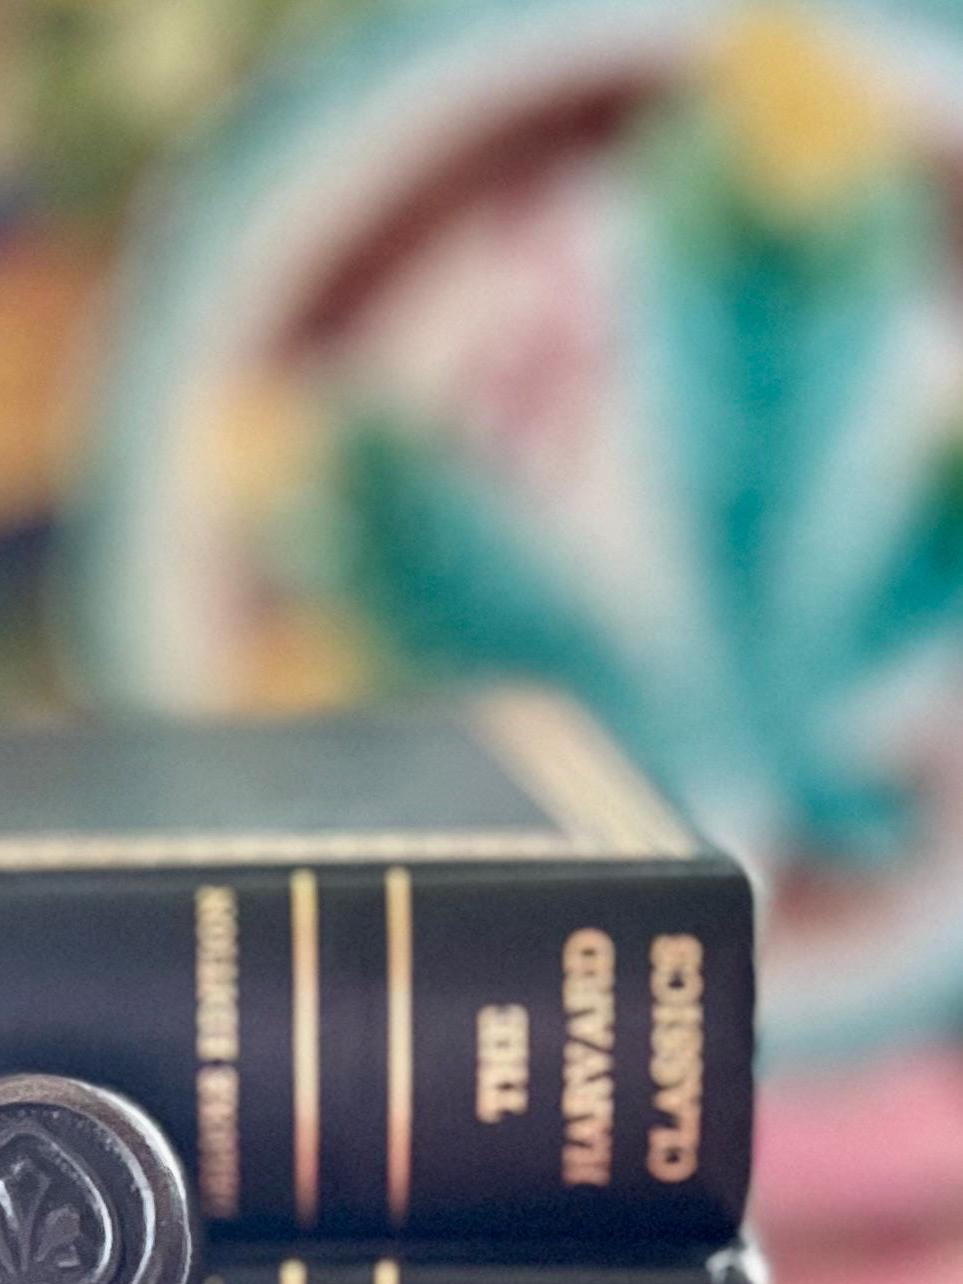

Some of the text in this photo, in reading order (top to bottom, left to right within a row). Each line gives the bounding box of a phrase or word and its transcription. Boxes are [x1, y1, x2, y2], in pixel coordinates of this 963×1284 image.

[476, 1004, 528, 1123] THE
[562, 927, 615, 1186] HARVARD
[647, 933, 703, 1183] CLASSICS
